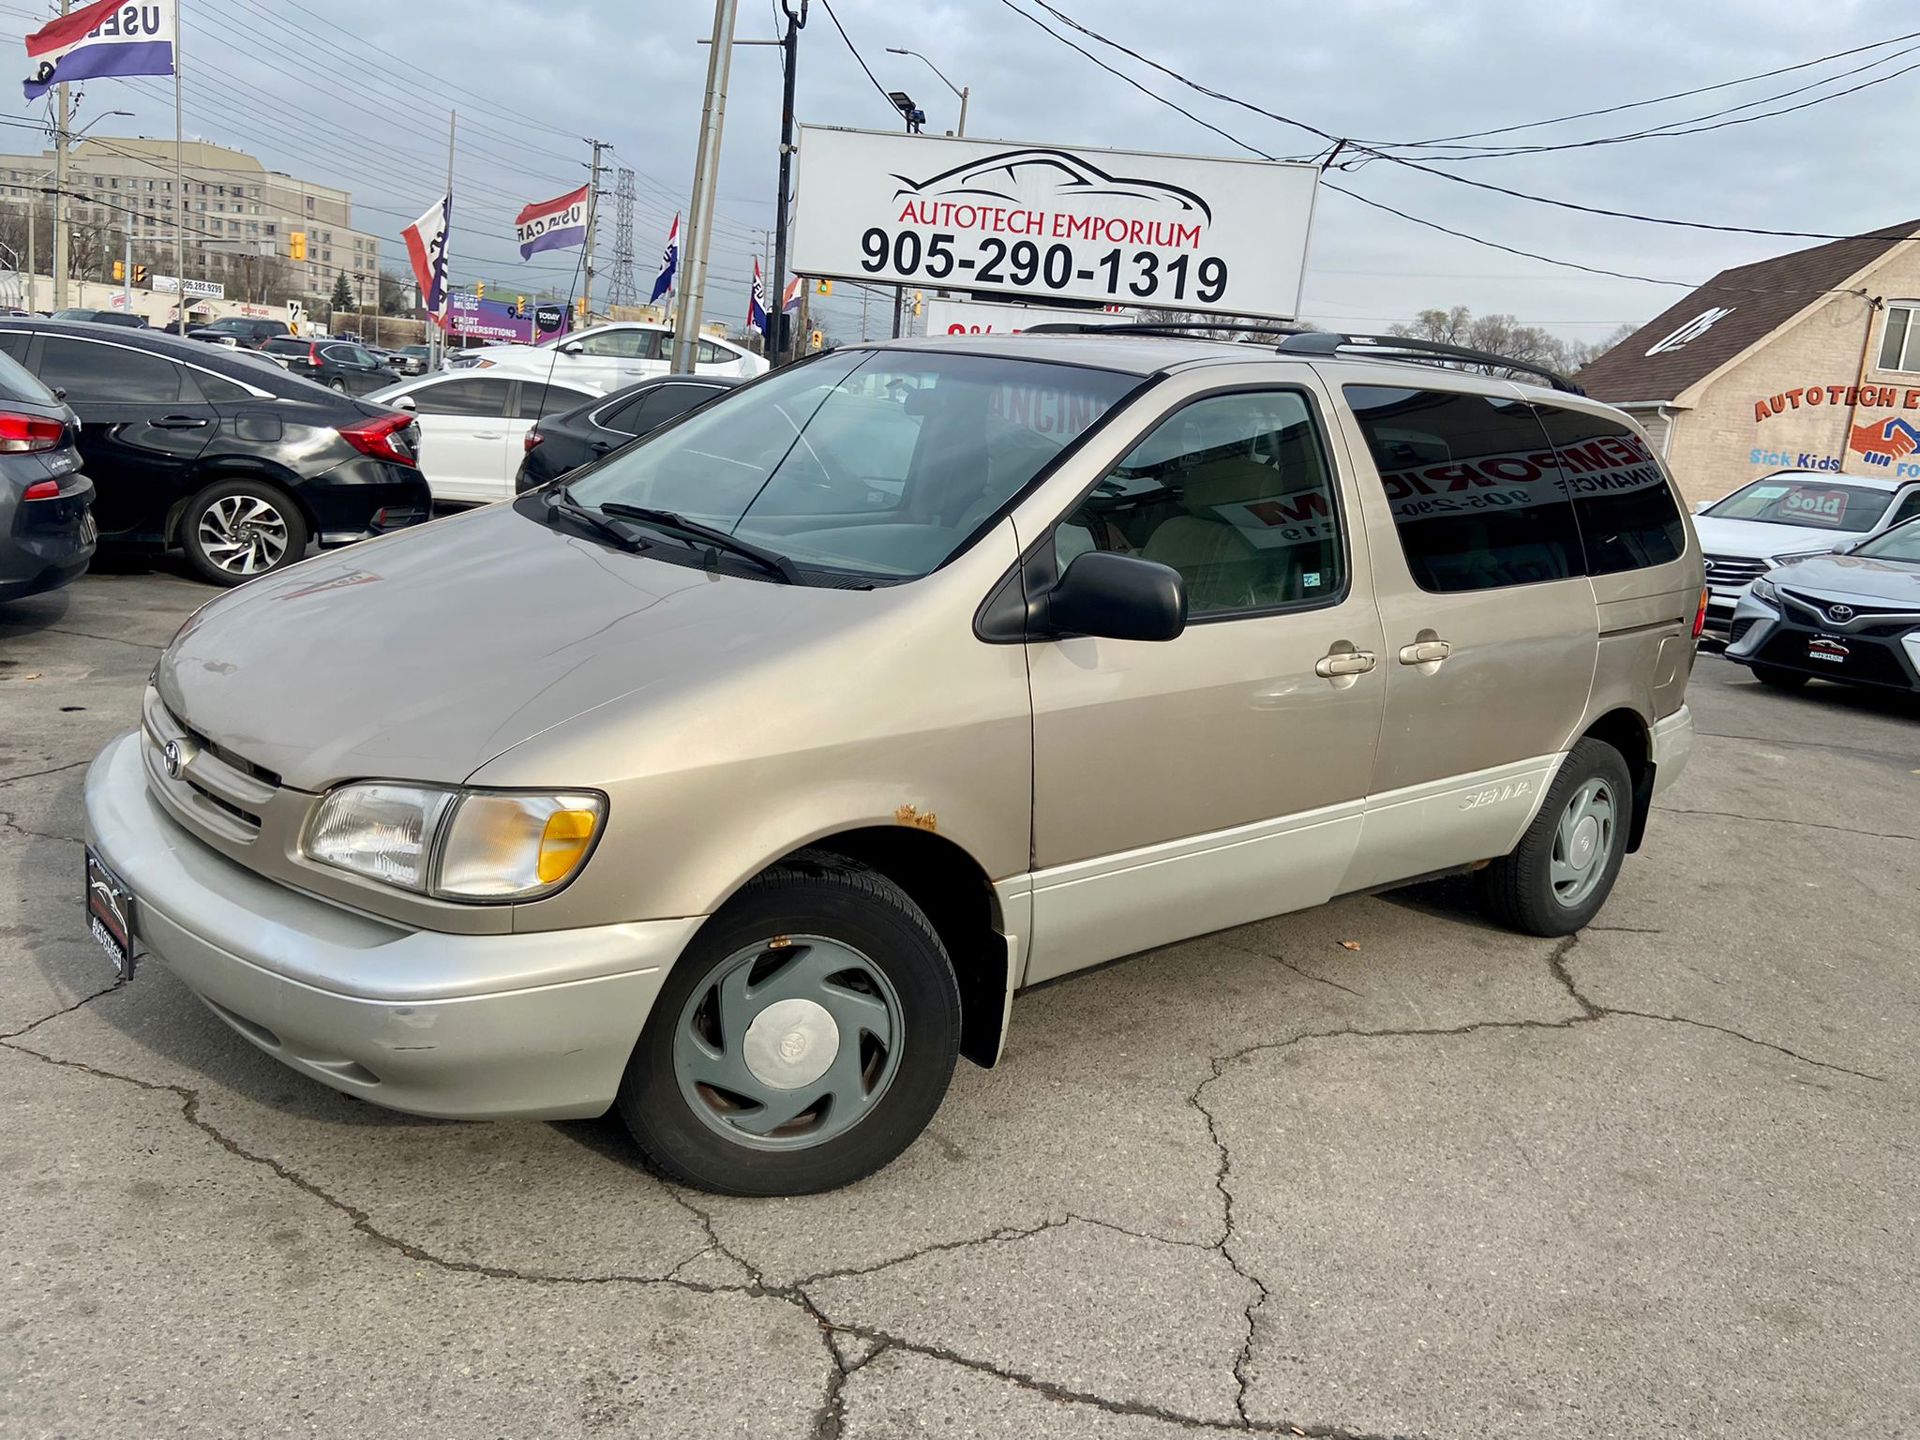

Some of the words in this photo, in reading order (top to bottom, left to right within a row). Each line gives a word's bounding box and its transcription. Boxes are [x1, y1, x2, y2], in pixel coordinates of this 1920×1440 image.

[898, 200, 1043, 236] AUTOTECH
[1052, 212, 1202, 249] EMPORIUM
[861, 227, 1228, 303] 905-290-1319
[538, 312, 560, 323] TODAY
[989, 385, 1099, 434] ANCIN
[1754, 385, 1897, 423] AUTOTECH
[1903, 389, 1920, 410] E
[1750, 449, 1792, 466] Sick
[1797, 453, 1841, 472] Kids
[1786, 491, 1840, 515] Sold
[1458, 780, 1533, 812] SIENNA
